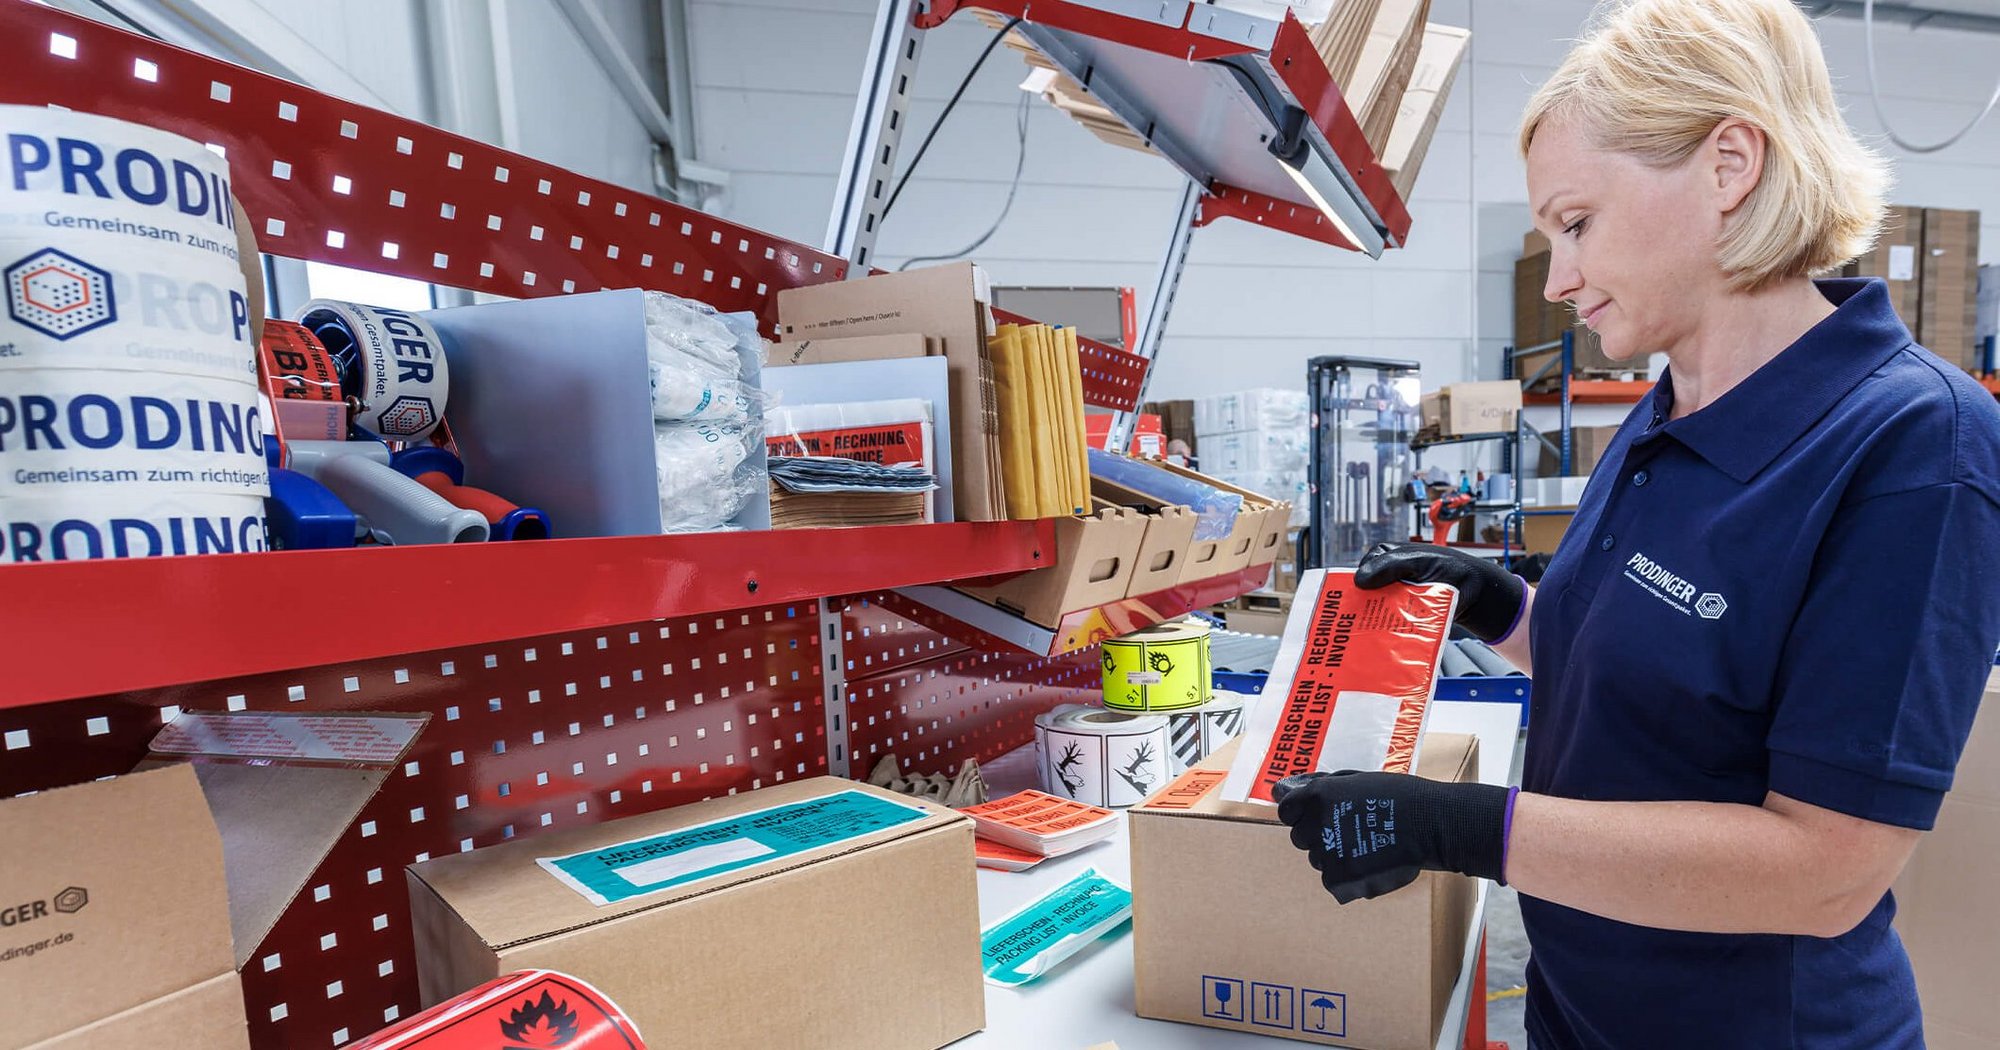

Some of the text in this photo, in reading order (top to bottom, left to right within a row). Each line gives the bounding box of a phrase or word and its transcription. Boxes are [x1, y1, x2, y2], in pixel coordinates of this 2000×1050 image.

[44, 211, 181, 243] Gemeinsam
[187, 234, 219, 254] zum
[365, 323, 388, 399] Gesamtpaket.
[835, 430, 904, 449] RECHNUNG
[14, 466, 260, 488] Gemeinsam zum richtigen
[1627, 552, 1696, 603] PRODINGER
[1126, 689, 1140, 703] 5.1
[1186, 685, 1198, 699] 5.1
[1265, 680, 1315, 784] LIEFERSCHEIN
[1307, 590, 1343, 665] RECHNUNG
[1290, 719, 1322, 776] ACKING
[1309, 683, 1334, 714] LIST
[1325, 613, 1356, 667] INVOICE
[752, 799, 848, 823] RECHNUNG
[982, 799, 1023, 811] Oben
[1003, 805, 1045, 817] Oben
[1024, 811, 1067, 823] Oben
[1047, 817, 1089, 830] Oben
[604, 838, 698, 866] PACKING
[700, 830, 740, 841] LIST
[754, 808, 824, 829] INVOICE
[0, 900, 49, 927] GER
[982, 916, 1050, 958] LIEFERSCHEIN
[995, 937, 1041, 965] PACKING
[1039, 925, 1061, 940] LIST
[1061, 901, 1099, 924] INVOICE
